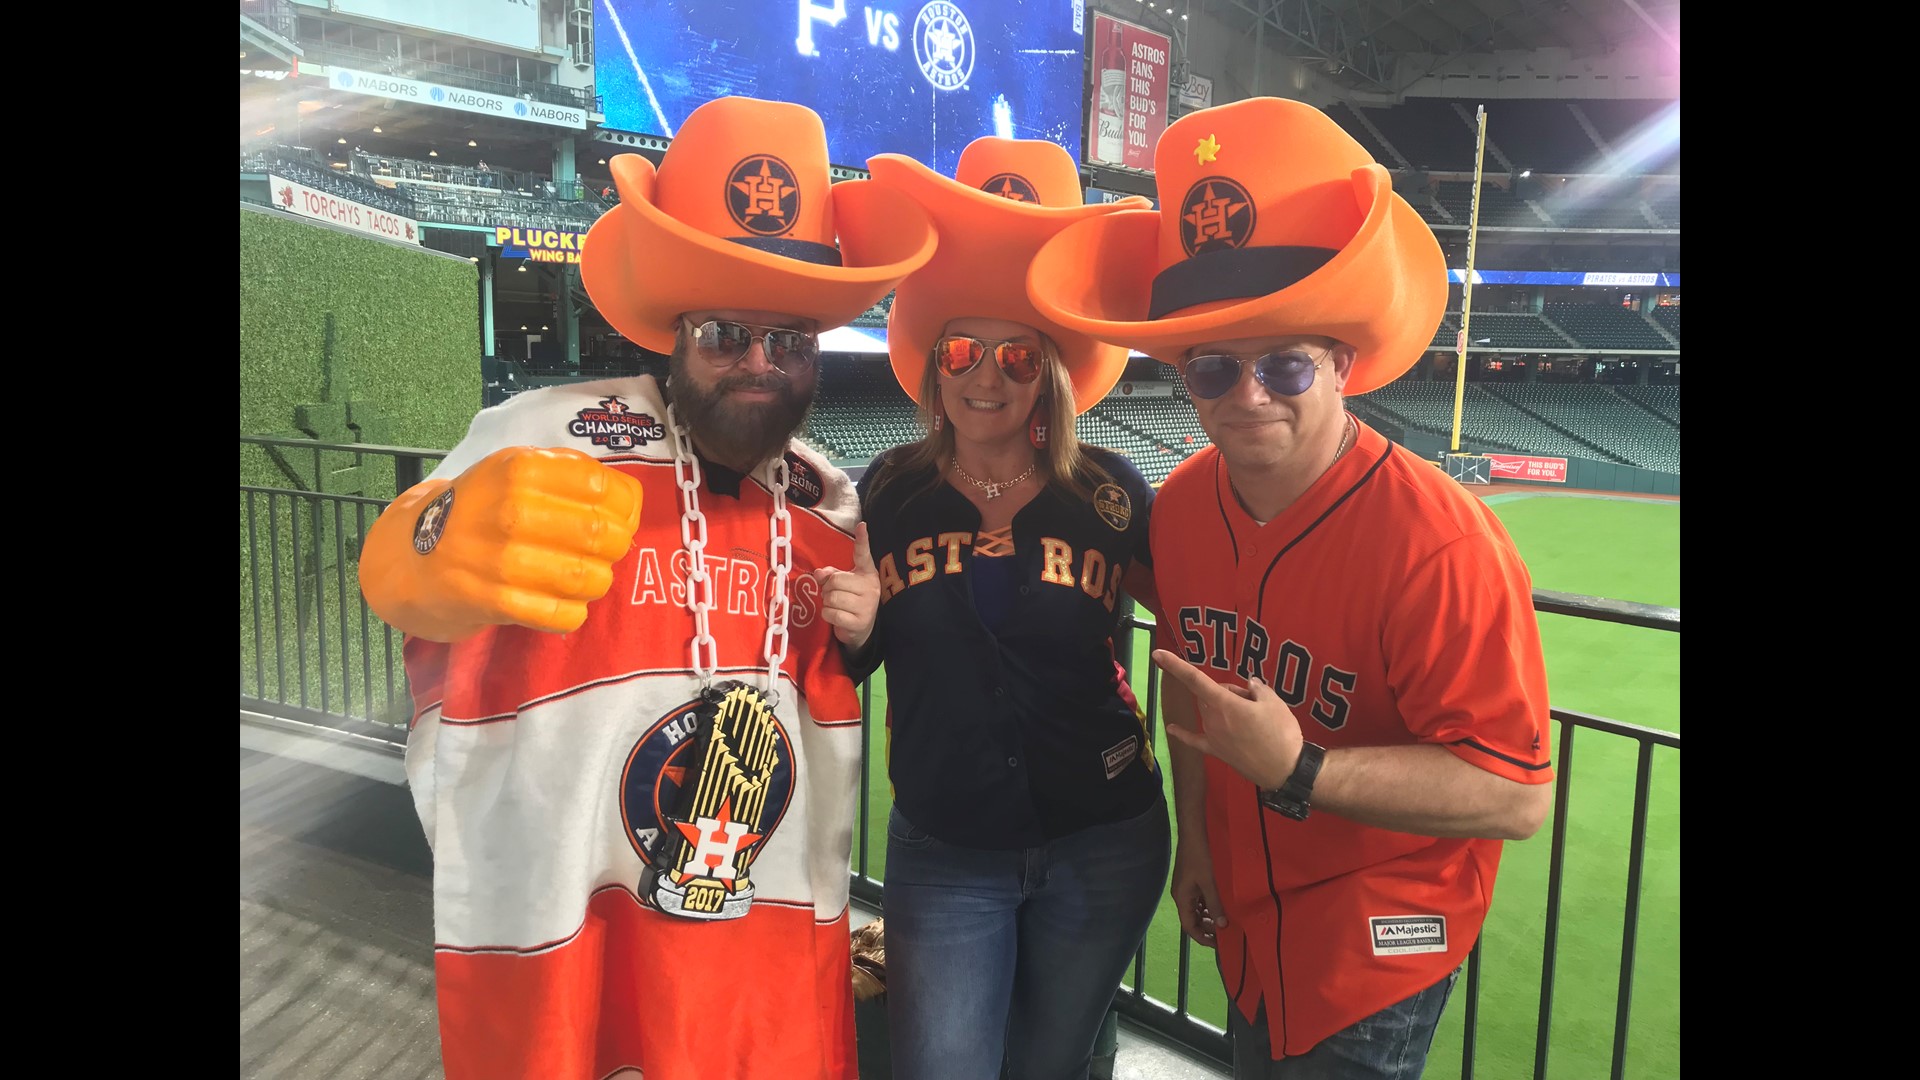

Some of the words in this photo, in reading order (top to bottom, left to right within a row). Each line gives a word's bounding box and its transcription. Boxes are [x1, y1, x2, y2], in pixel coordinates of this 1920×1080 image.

[864, 6, 900, 51] VS
[921, 4, 968, 35] HOUSTON
[1131, 42, 1165, 66] ASTROS
[922, 60, 965, 86] ASTROS
[1131, 59, 1155, 83] FANS,
[1131, 76, 1150, 96] THIS
[357, 76, 418, 97] NABORS
[448, 91, 503, 111] NABORS
[530, 105, 580, 124] NABORS
[1130, 95, 1156, 116] BUD'S
[1129, 112, 1147, 131] FOR
[1128, 130, 1148, 148] YOU.
[302, 190, 361, 226] TORCHYS
[366, 210, 400, 236] TACOS
[529, 248, 564, 262] WING
[1586, 274, 1617, 283] PIRATES
[1627, 275, 1655, 284] ASTROS
[572, 421, 663, 438] CHAMPIONS
[581, 413, 619, 422] WORLD
[620, 416, 652, 427] SERIES
[1036, 426, 1047, 442] H
[1542, 469, 1557, 477] YOU.
[1544, 462, 1564, 470] BUD'S
[788, 470, 820, 497] RONG
[985, 483, 1001, 499] H
[631, 547, 819, 628] ASTROS
[1178, 605, 1358, 732] STROS
[683, 816, 750, 880] H
[683, 886, 725, 913] 2017
[1395, 924, 1437, 936] Majestic
